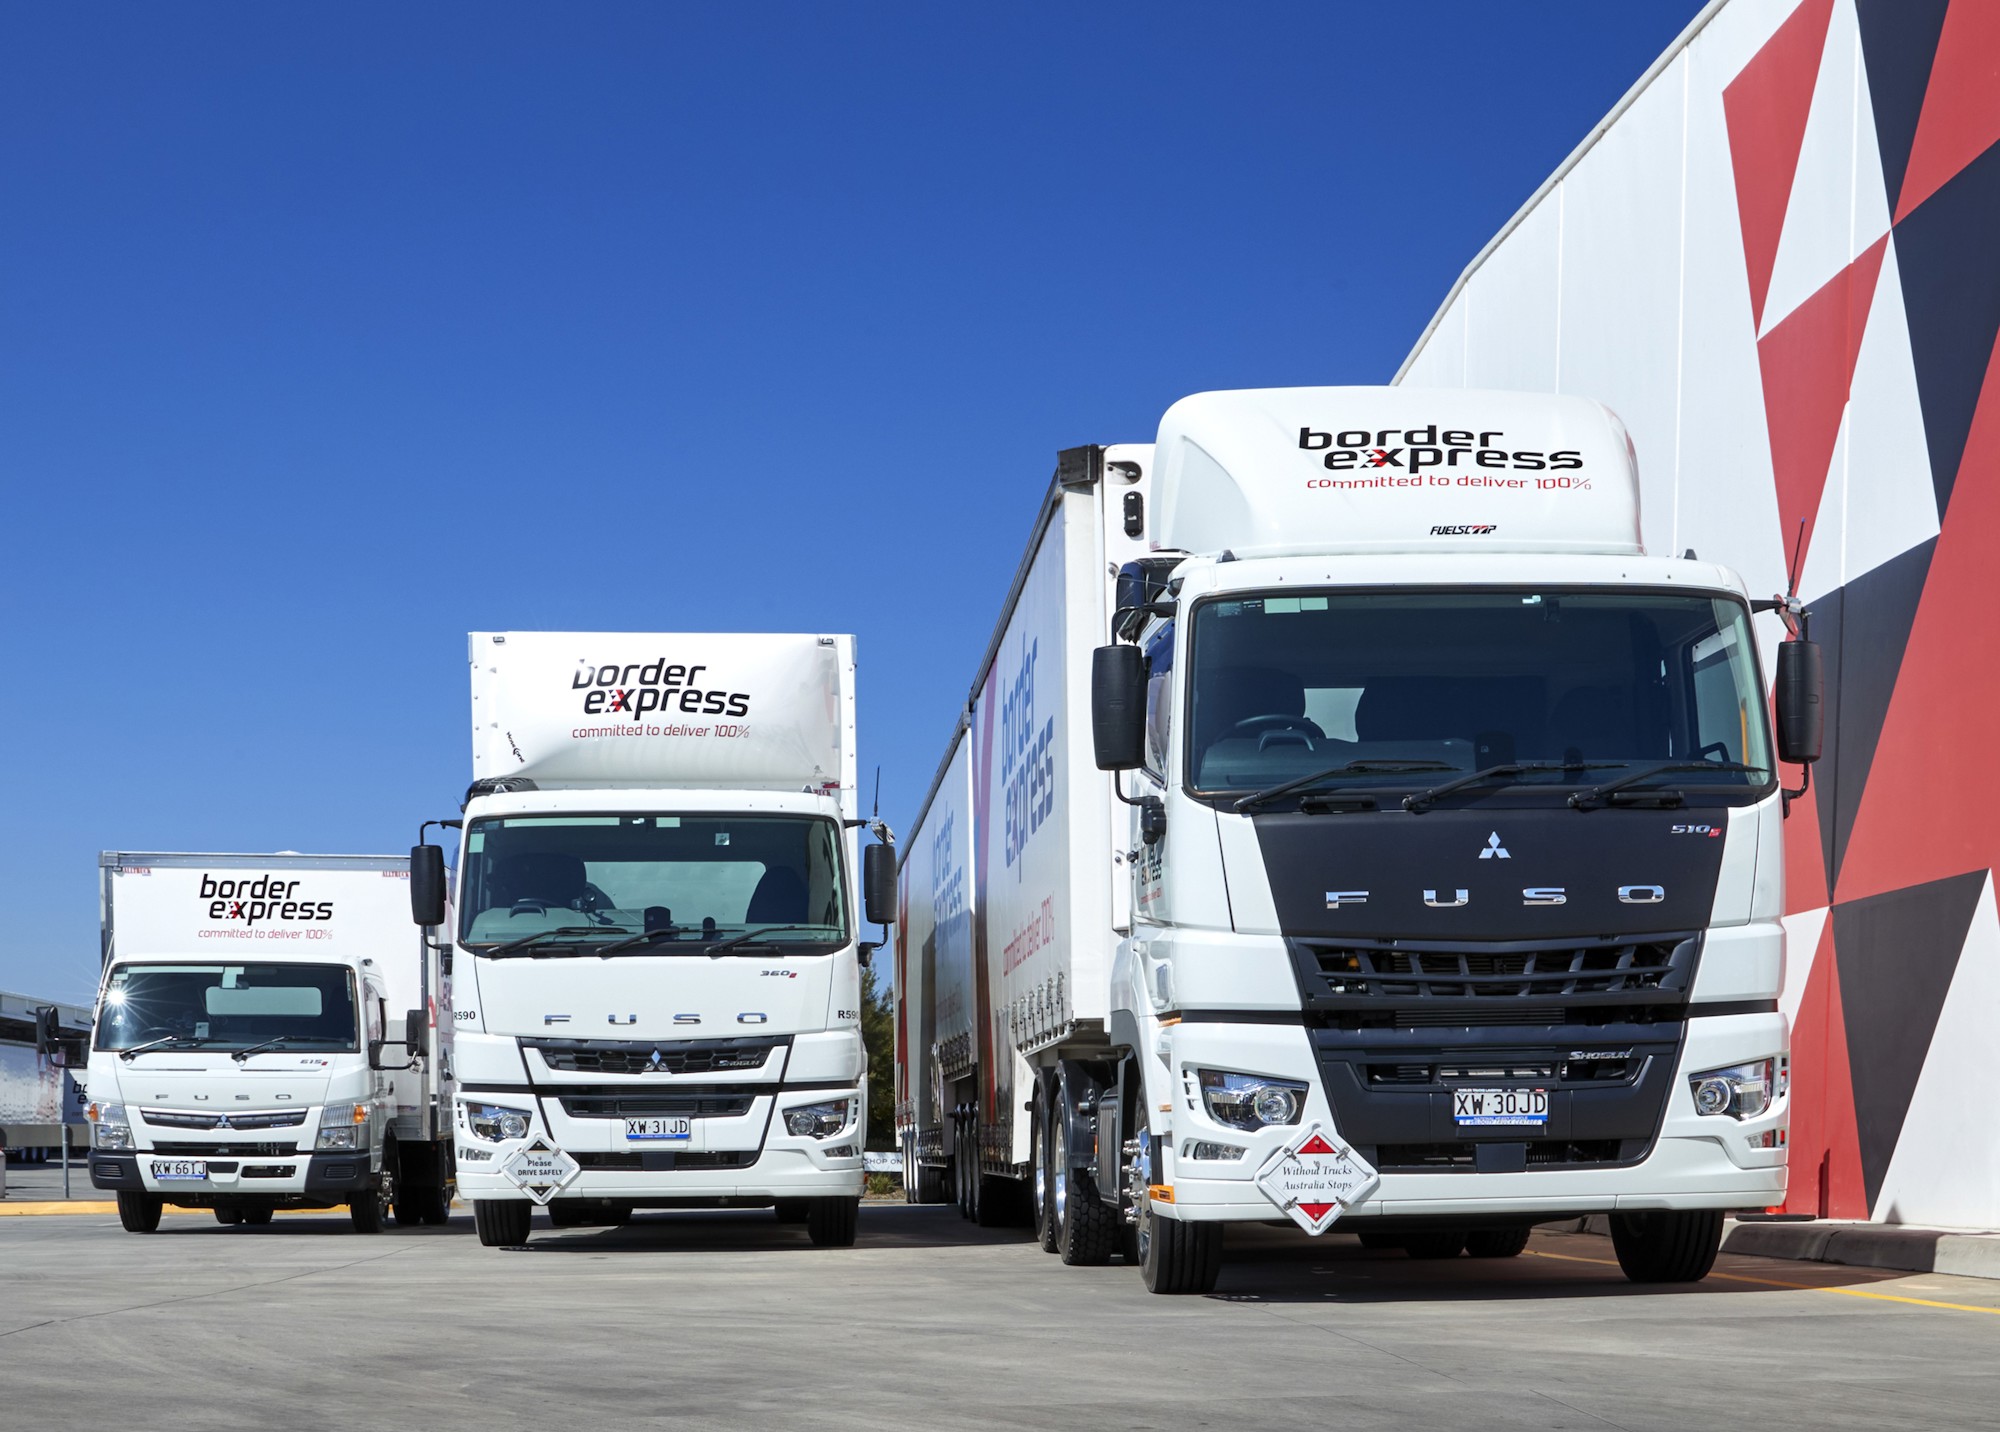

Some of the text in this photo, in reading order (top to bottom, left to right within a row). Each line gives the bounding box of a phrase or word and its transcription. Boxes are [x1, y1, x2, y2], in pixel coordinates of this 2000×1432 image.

[1299, 425, 1503, 450] border
[1324, 448, 1583, 473] express
[1307, 475, 1591, 490] committed to deliver 100%
[572, 657, 707, 689] border
[584, 688, 750, 721] express
[1002, 631, 1038, 788] border
[572, 724, 751, 738] committed to deliver 100%
[1005, 715, 1054, 884] express
[200, 874, 300, 899] border
[1326, 884, 1665, 909] FUSO
[209, 900, 333, 926] express
[198, 929, 333, 940] committed to deliver 100%
[453, 1011, 476, 1020] R590
[544, 1012, 767, 1025] FUSO
[1569, 1050, 1632, 1060] SHOGUN
[1283, 1165, 1352, 1175] Without Trucks
[1283, 1180, 1352, 1192] Australia Stops
